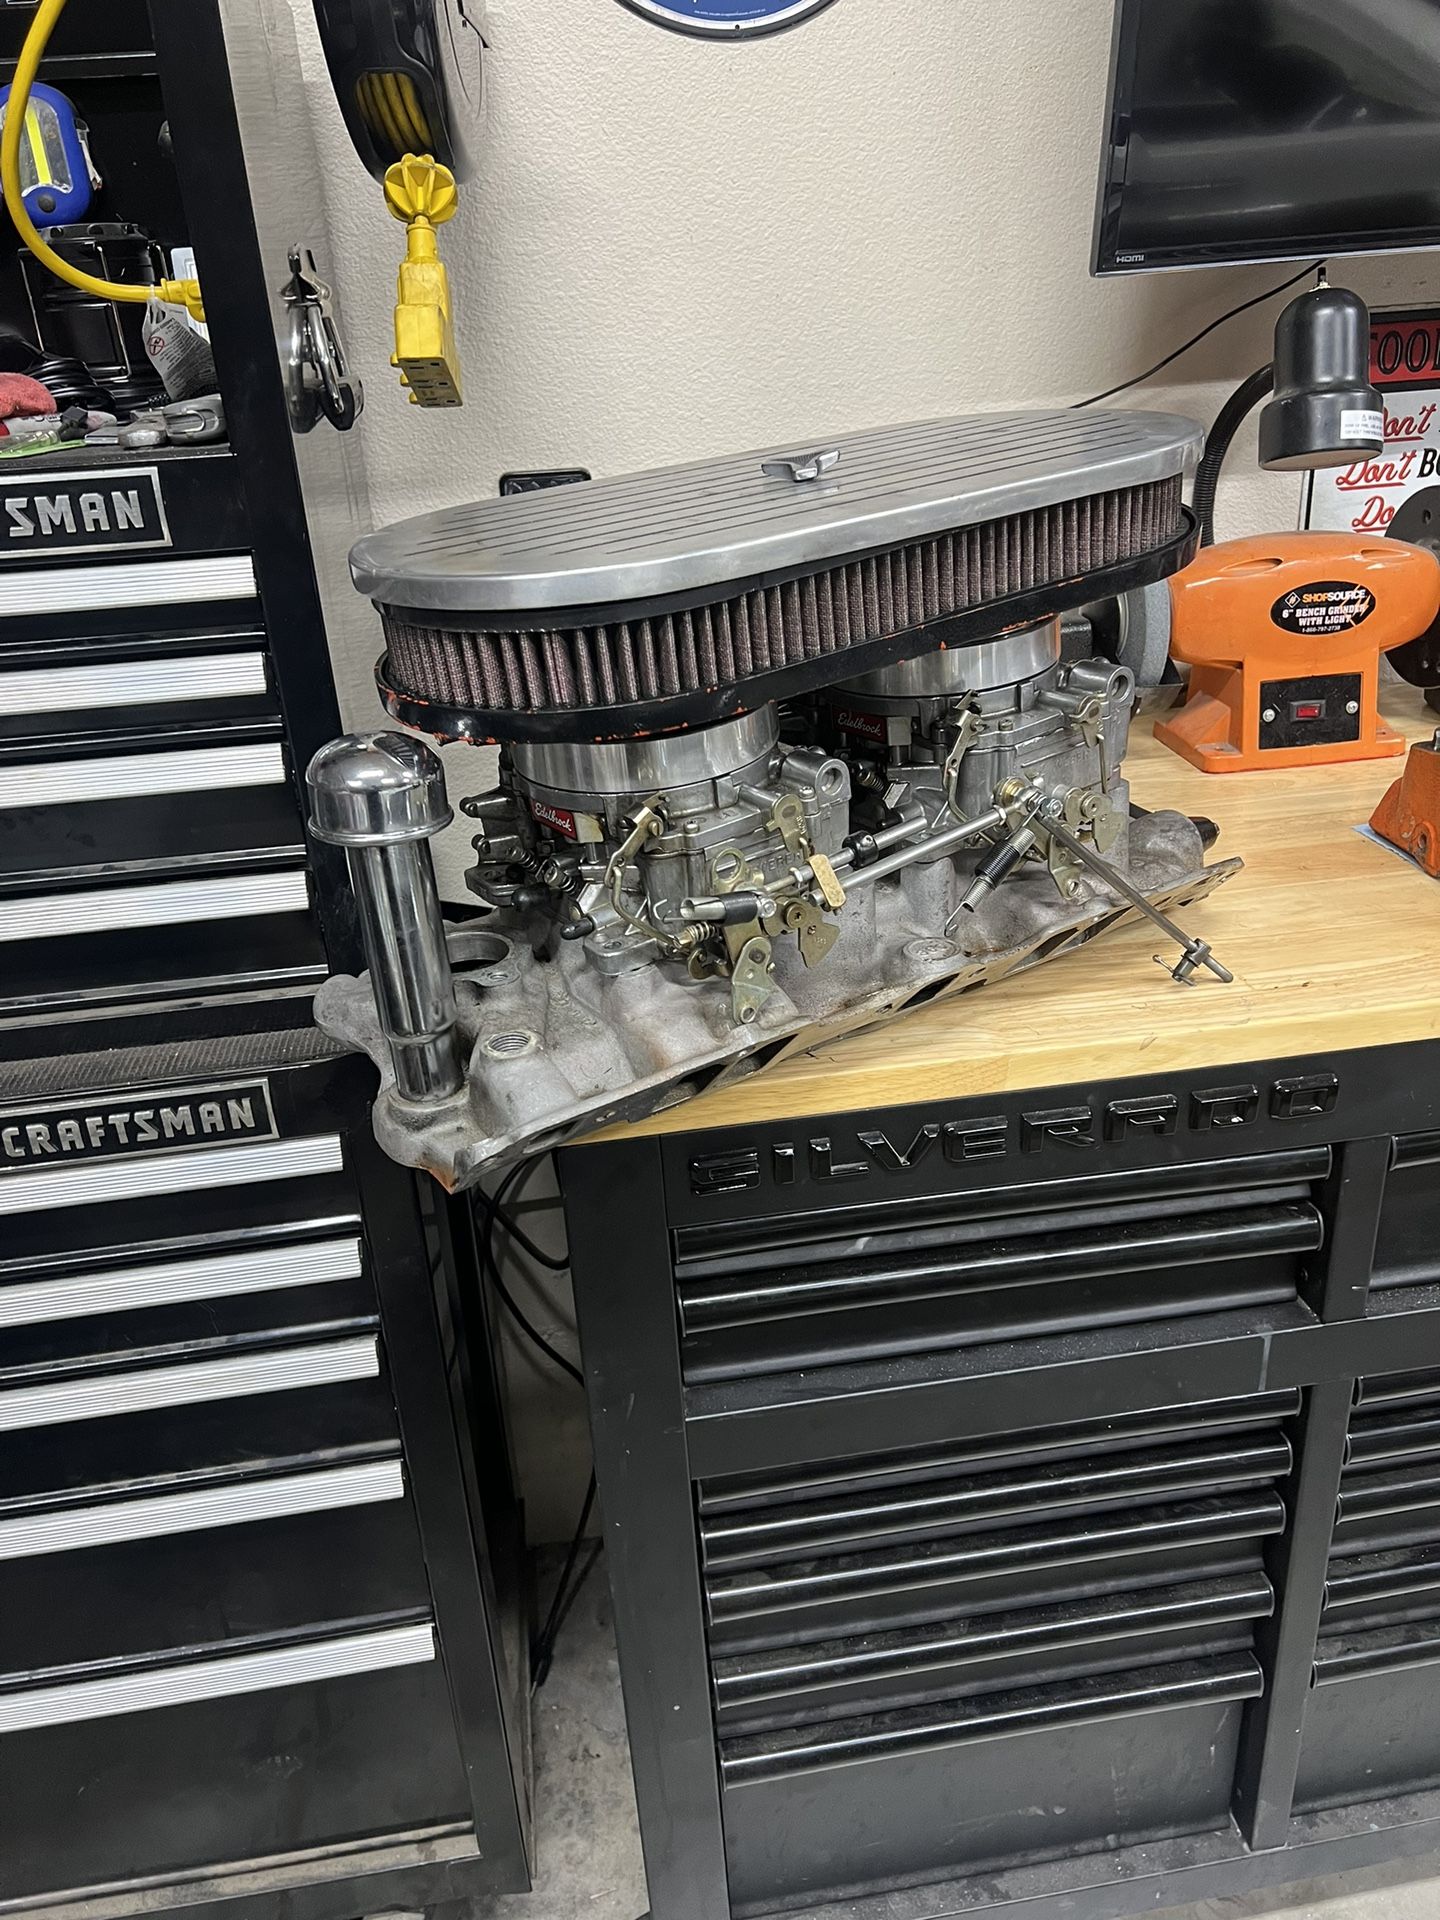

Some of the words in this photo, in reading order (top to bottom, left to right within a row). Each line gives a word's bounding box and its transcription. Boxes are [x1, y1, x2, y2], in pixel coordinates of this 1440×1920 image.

[1116, 254, 1145, 263] HDMI
[1336, 449, 1417, 485] Don't
[1417, 447, 1440, 478] B
[1302, 589, 1366, 603] SHOPSOURCE
[1295, 606, 1326, 618] BENCH
[1298, 617, 1323, 627] WITH
[1324, 614, 1351, 625] LIGHT
[838, 711, 881, 736] Edelbrock
[534, 802, 572, 832] Edelbrock
[1, 1097, 256, 1158] CRAFTSMAN
[689, 1073, 1339, 1195] SILVERADO
